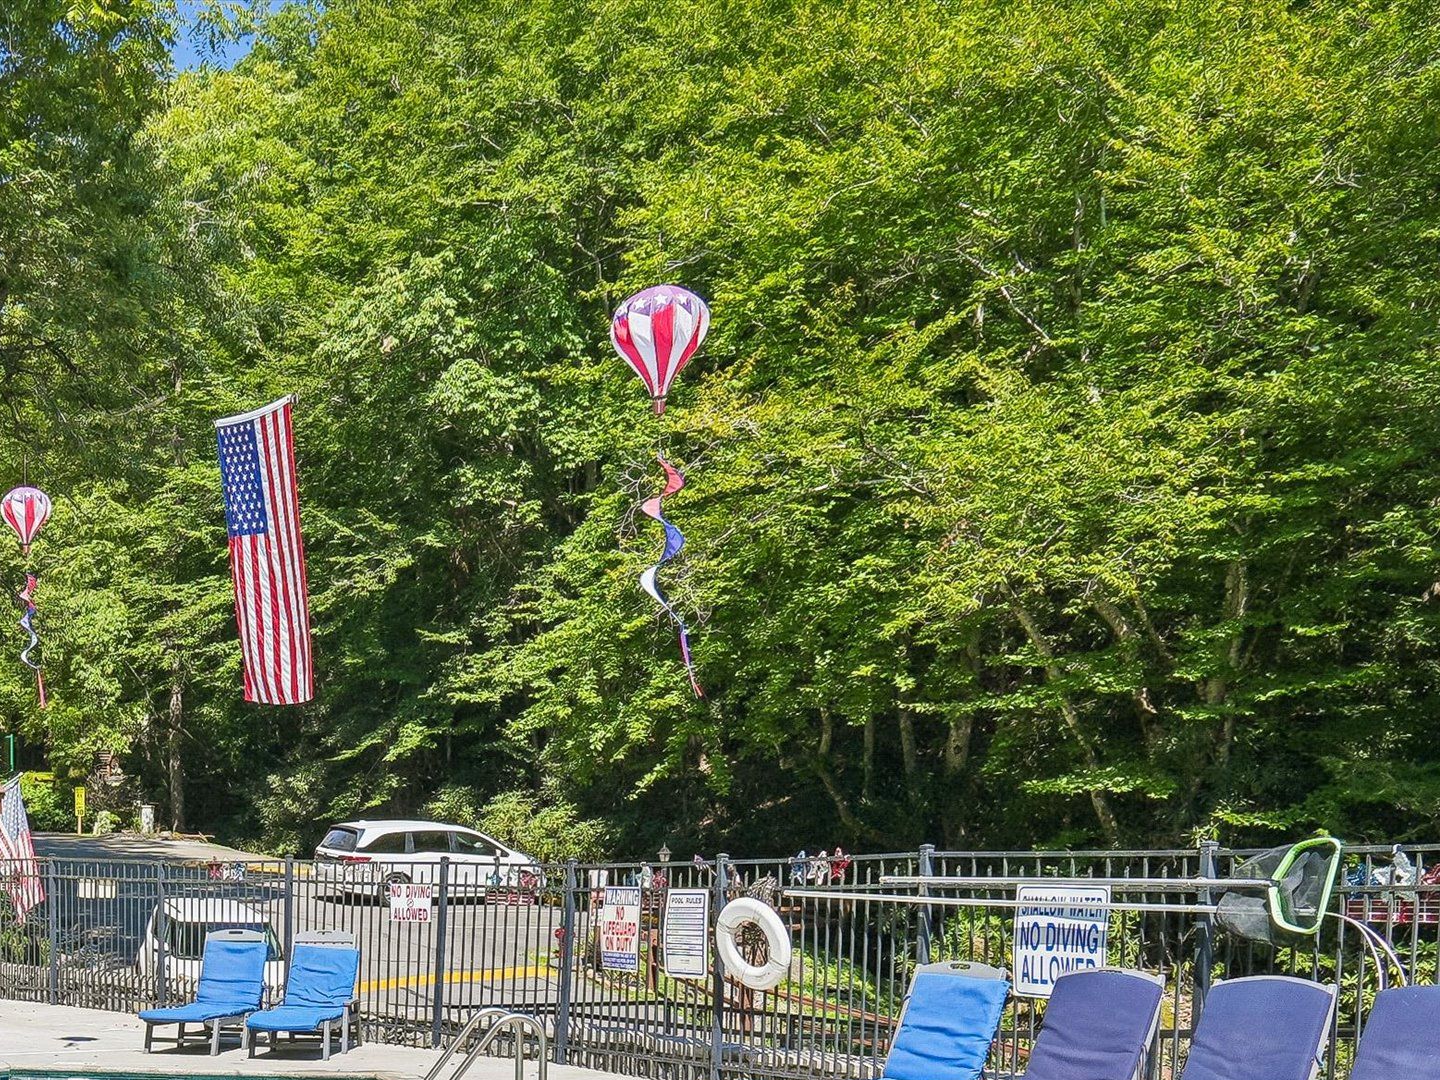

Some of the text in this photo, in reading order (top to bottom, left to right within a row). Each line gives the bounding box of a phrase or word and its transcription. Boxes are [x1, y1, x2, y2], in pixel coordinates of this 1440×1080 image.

[391, 886, 430, 899] NO DIVING
[605, 890, 639, 905] WARNING
[393, 908, 428, 921] ALLOWED
[616, 906, 625, 920] NO
[1021, 896, 1102, 918] SHALLOW WATER
[603, 921, 636, 937] LIFEGUARD
[605, 936, 633, 951] ON DUTY
[1020, 921, 1099, 954] NO DIVING
